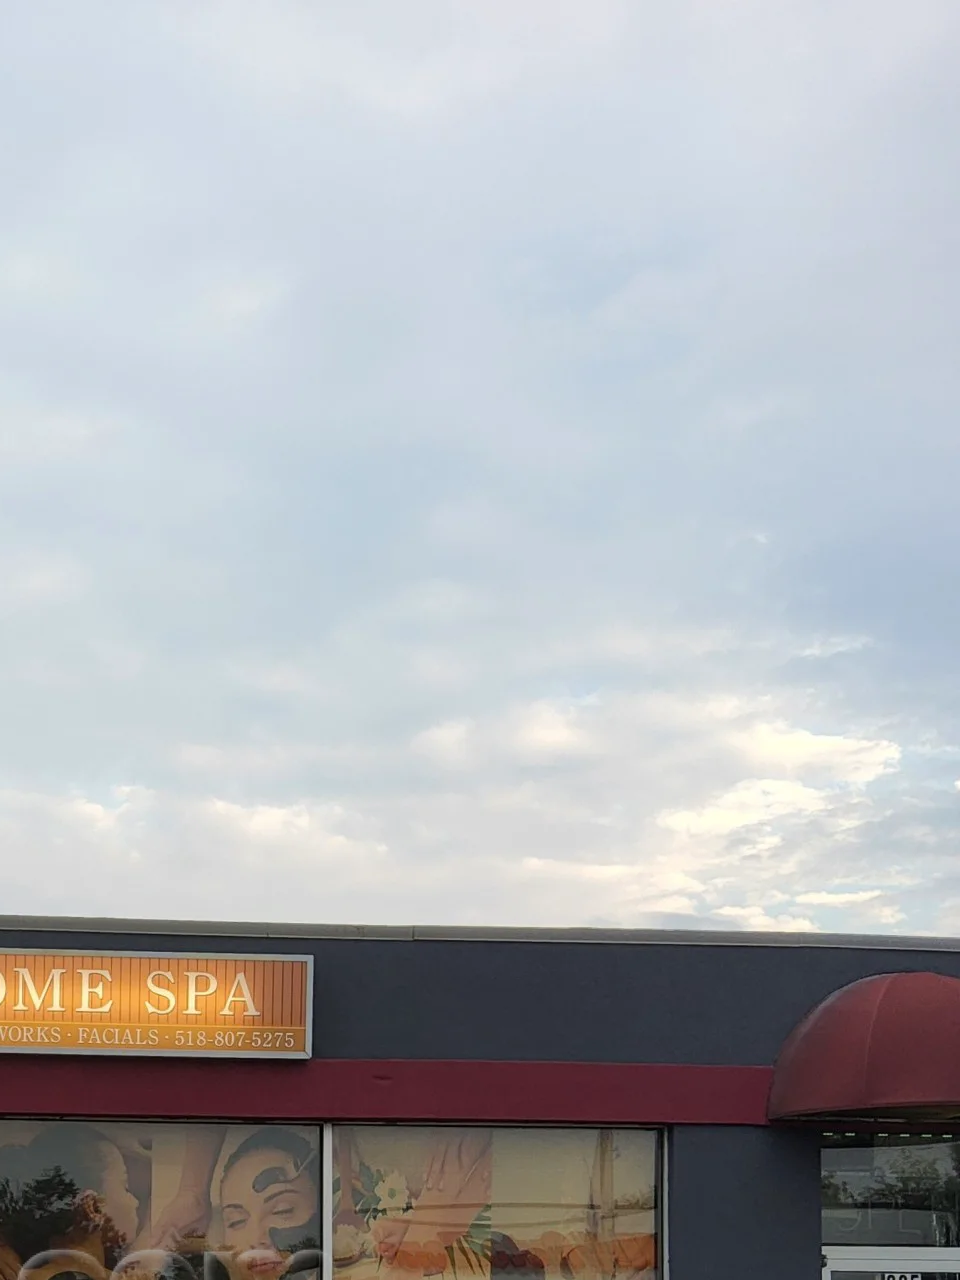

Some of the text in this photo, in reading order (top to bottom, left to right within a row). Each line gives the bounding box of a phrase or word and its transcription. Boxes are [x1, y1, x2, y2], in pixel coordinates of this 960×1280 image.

[143, 970, 261, 1018] SPA
[77, 1027, 159, 1045] FACIALS
[174, 1030, 295, 1048] 518-807-5275
